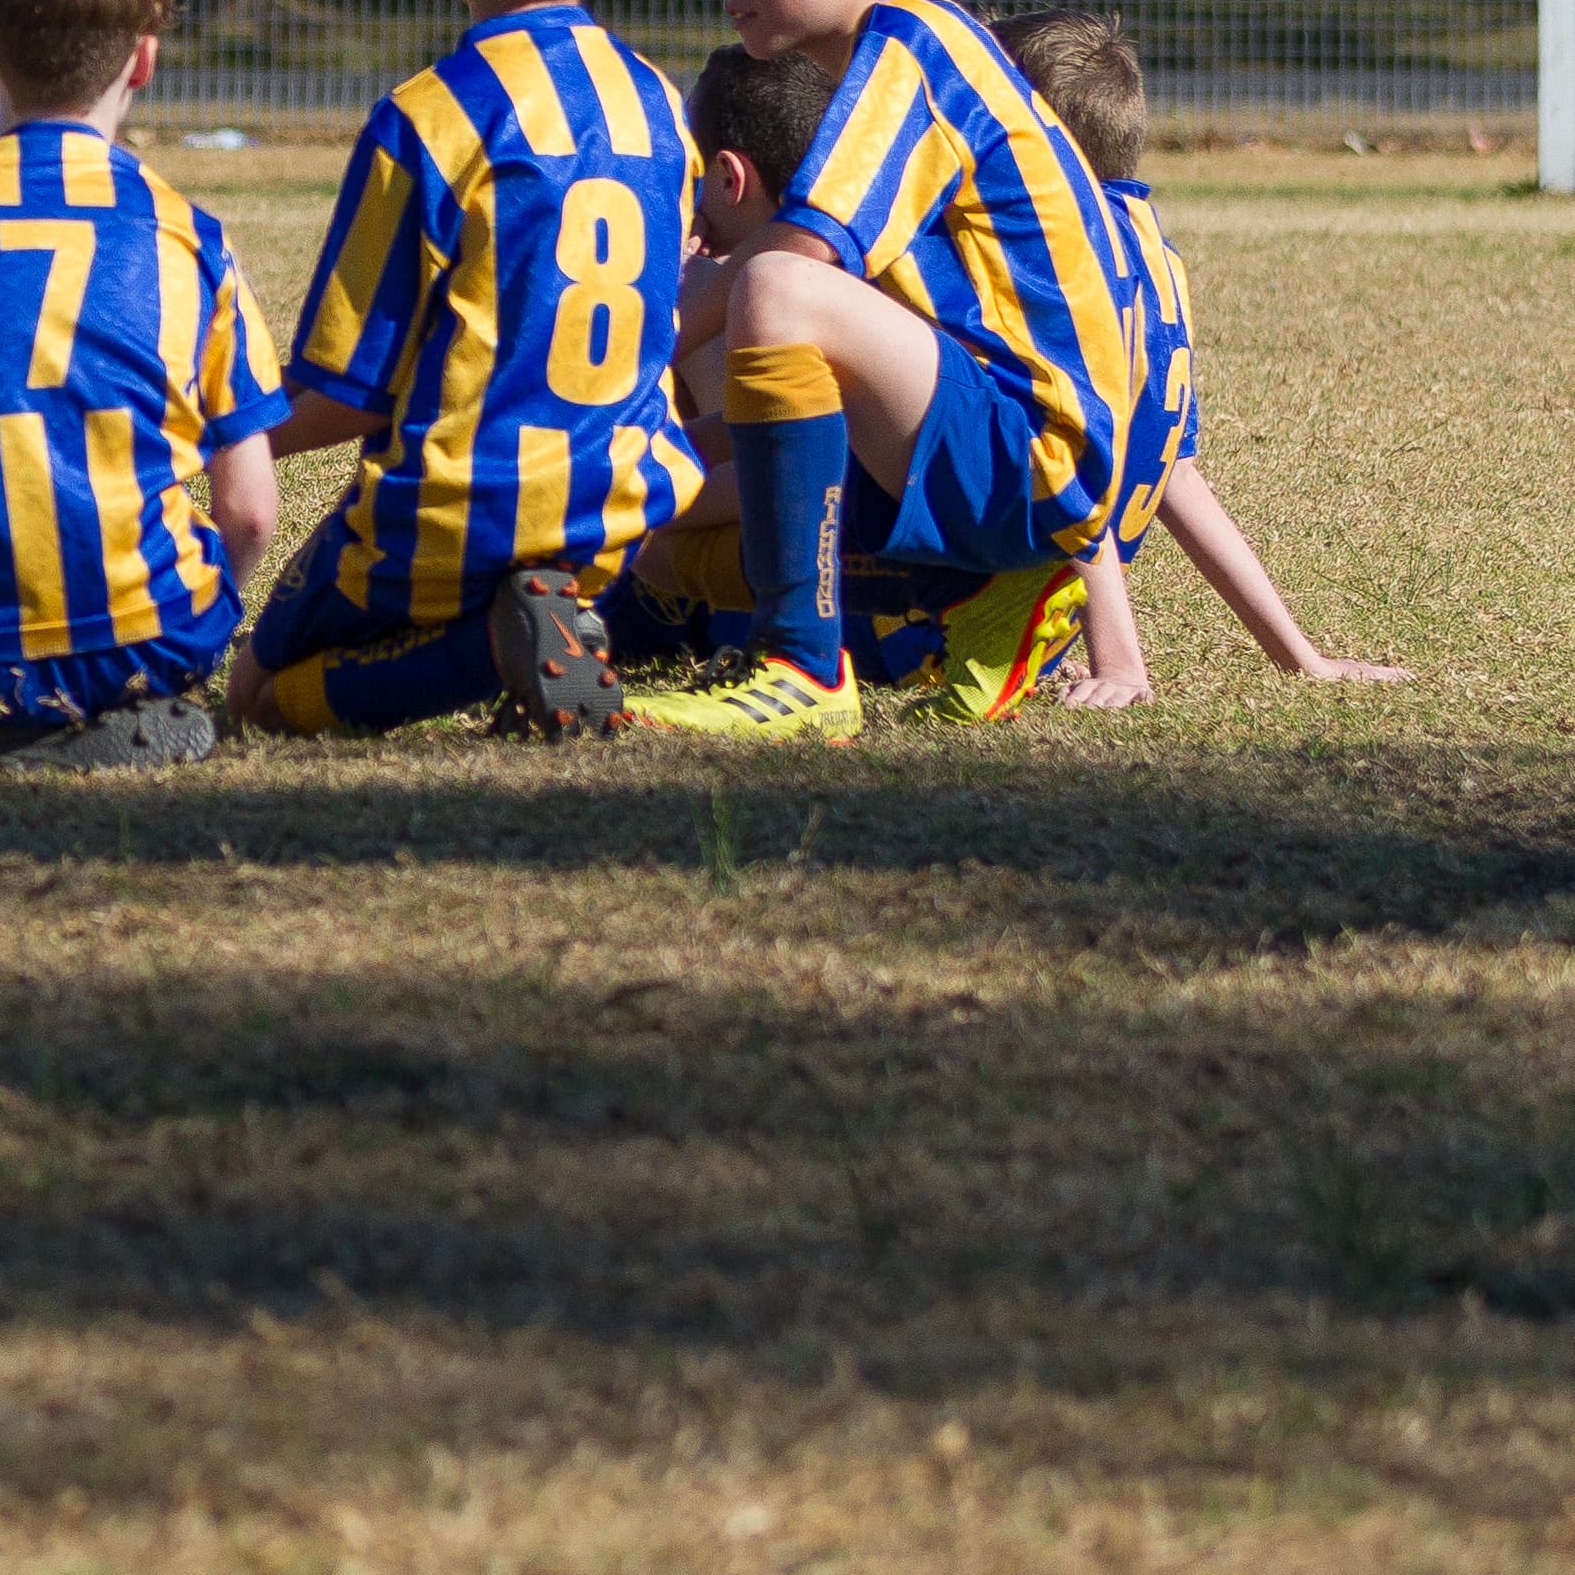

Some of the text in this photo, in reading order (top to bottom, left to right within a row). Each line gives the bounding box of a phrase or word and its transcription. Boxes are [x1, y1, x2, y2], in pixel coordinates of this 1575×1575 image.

[547, 178, 646, 406] 8
[1118, 347, 1191, 543] 3
[816, 485, 842, 618] RICHMOND
